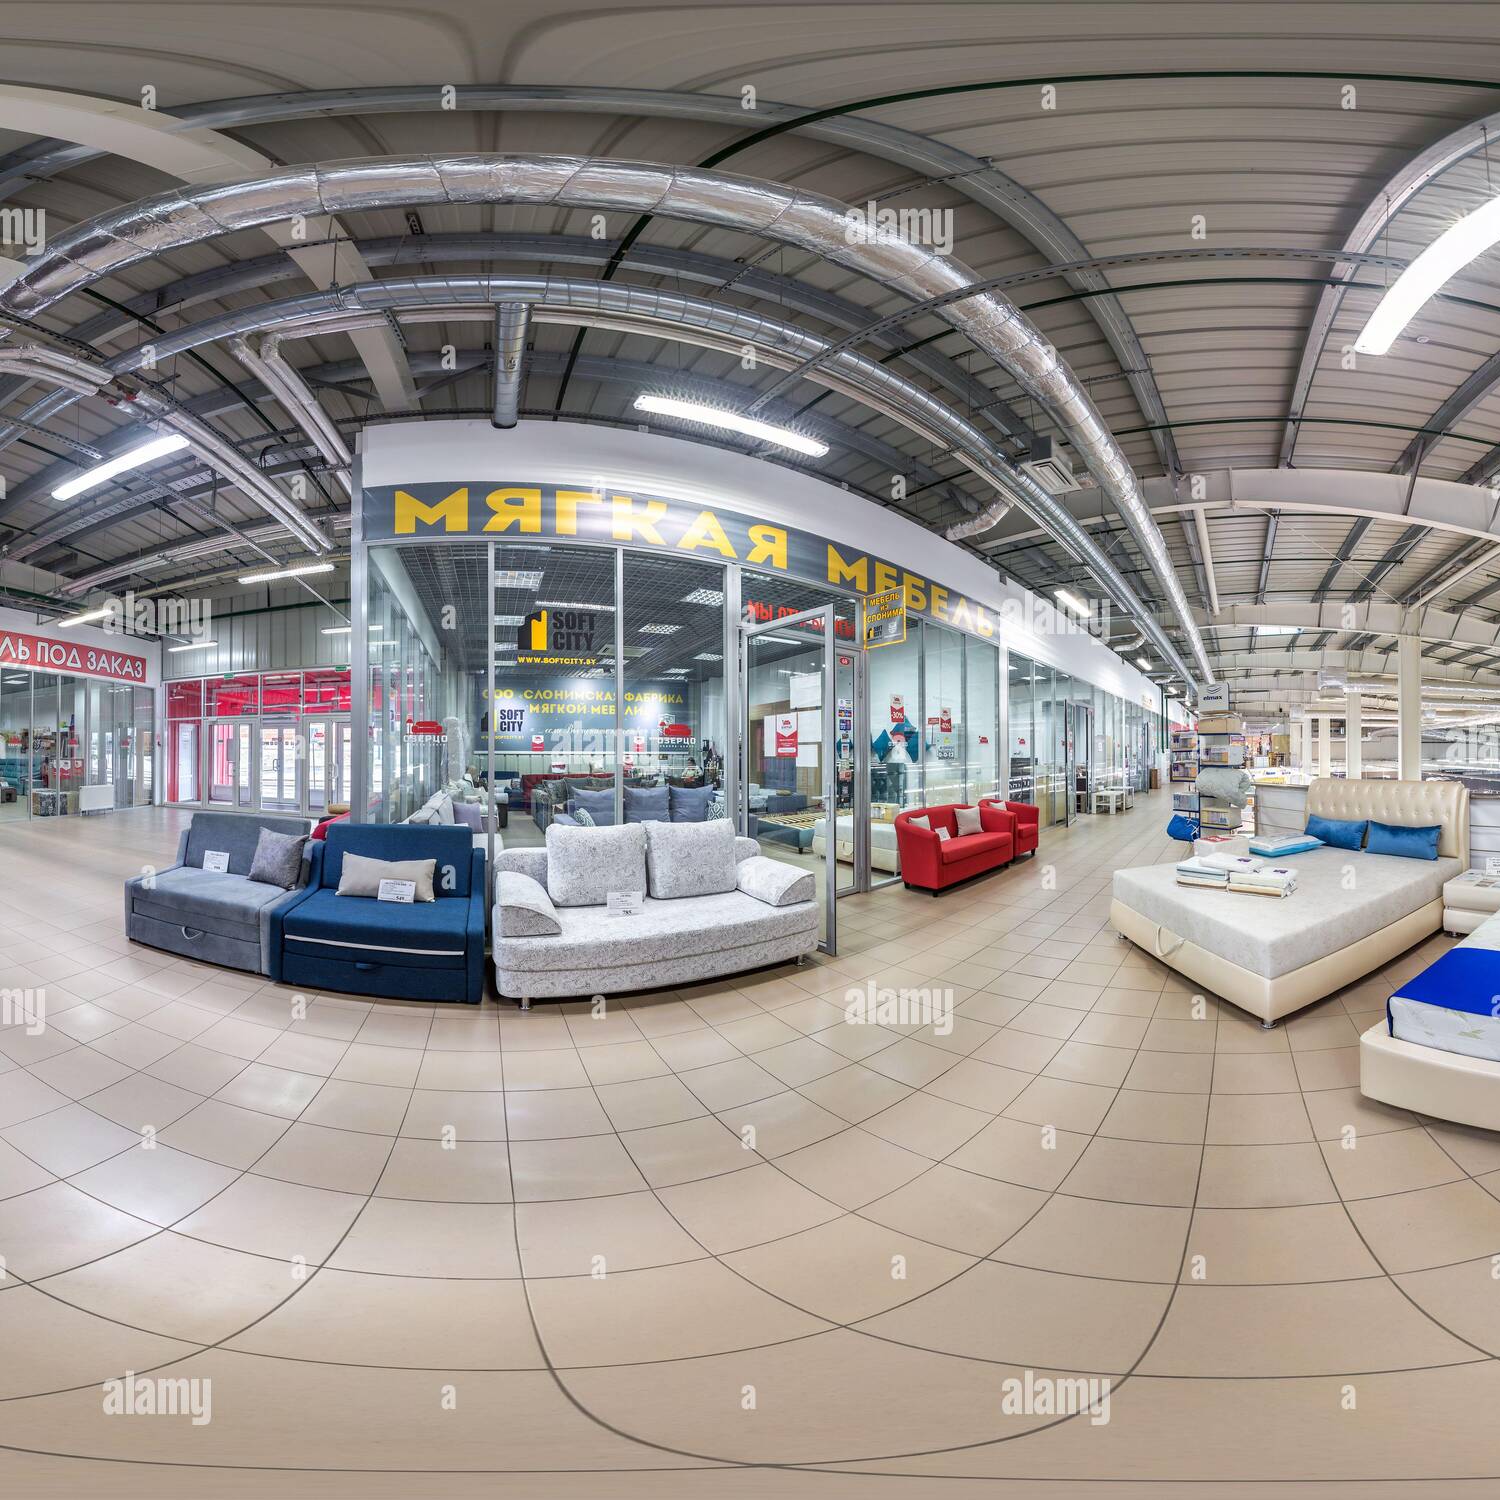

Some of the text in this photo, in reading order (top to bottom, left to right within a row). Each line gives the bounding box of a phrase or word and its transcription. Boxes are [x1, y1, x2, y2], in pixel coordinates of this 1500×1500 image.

[394, 487, 994, 638] МЯГКАЯ МЕБЕЛЬ
[552, 611, 596, 629] SOFT
[552, 631, 595, 650] CITY
[37, 641, 82, 669] ПОД
[87, 650, 143, 679] ЗАКАЗ
[500, 709, 525, 720] SOFT
[529, 704, 587, 715] МЯГКОЙ
[500, 720, 523, 732] CITY
